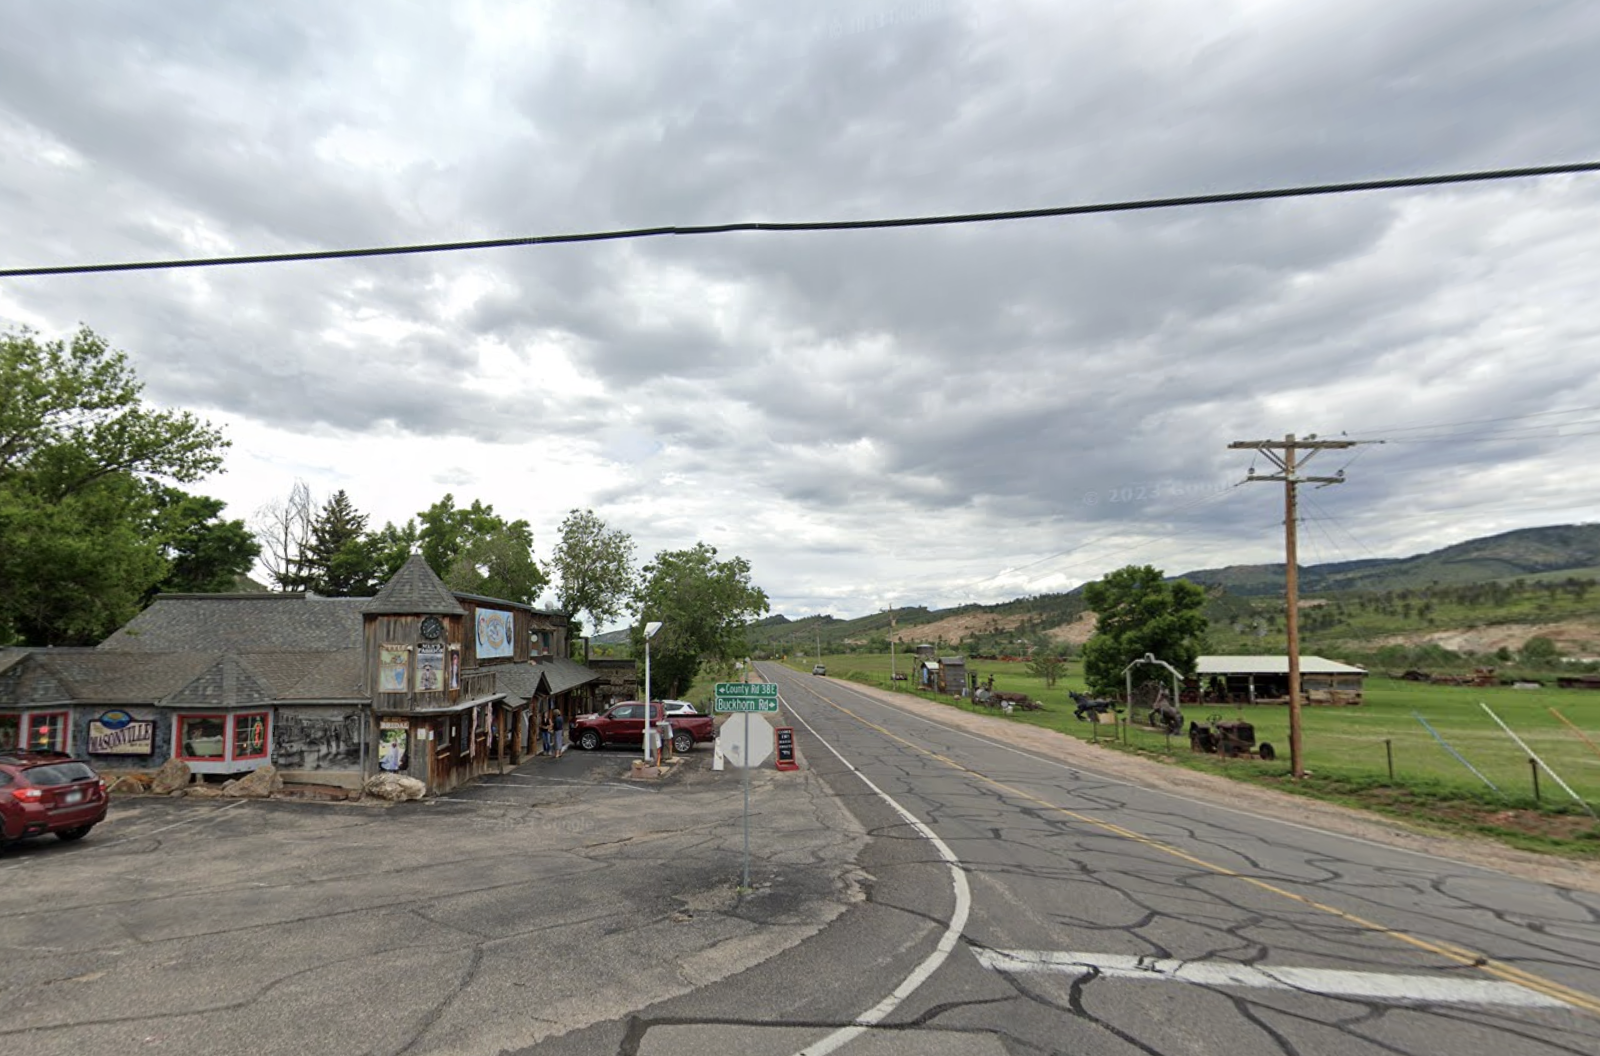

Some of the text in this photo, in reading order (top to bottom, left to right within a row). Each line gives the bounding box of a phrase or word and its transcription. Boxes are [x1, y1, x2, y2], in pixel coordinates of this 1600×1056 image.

[725, 684, 776, 695] County Rd 38E
[718, 698, 769, 710] Buckhorn Rd
[90, 723, 151, 753] MASONVILLE
